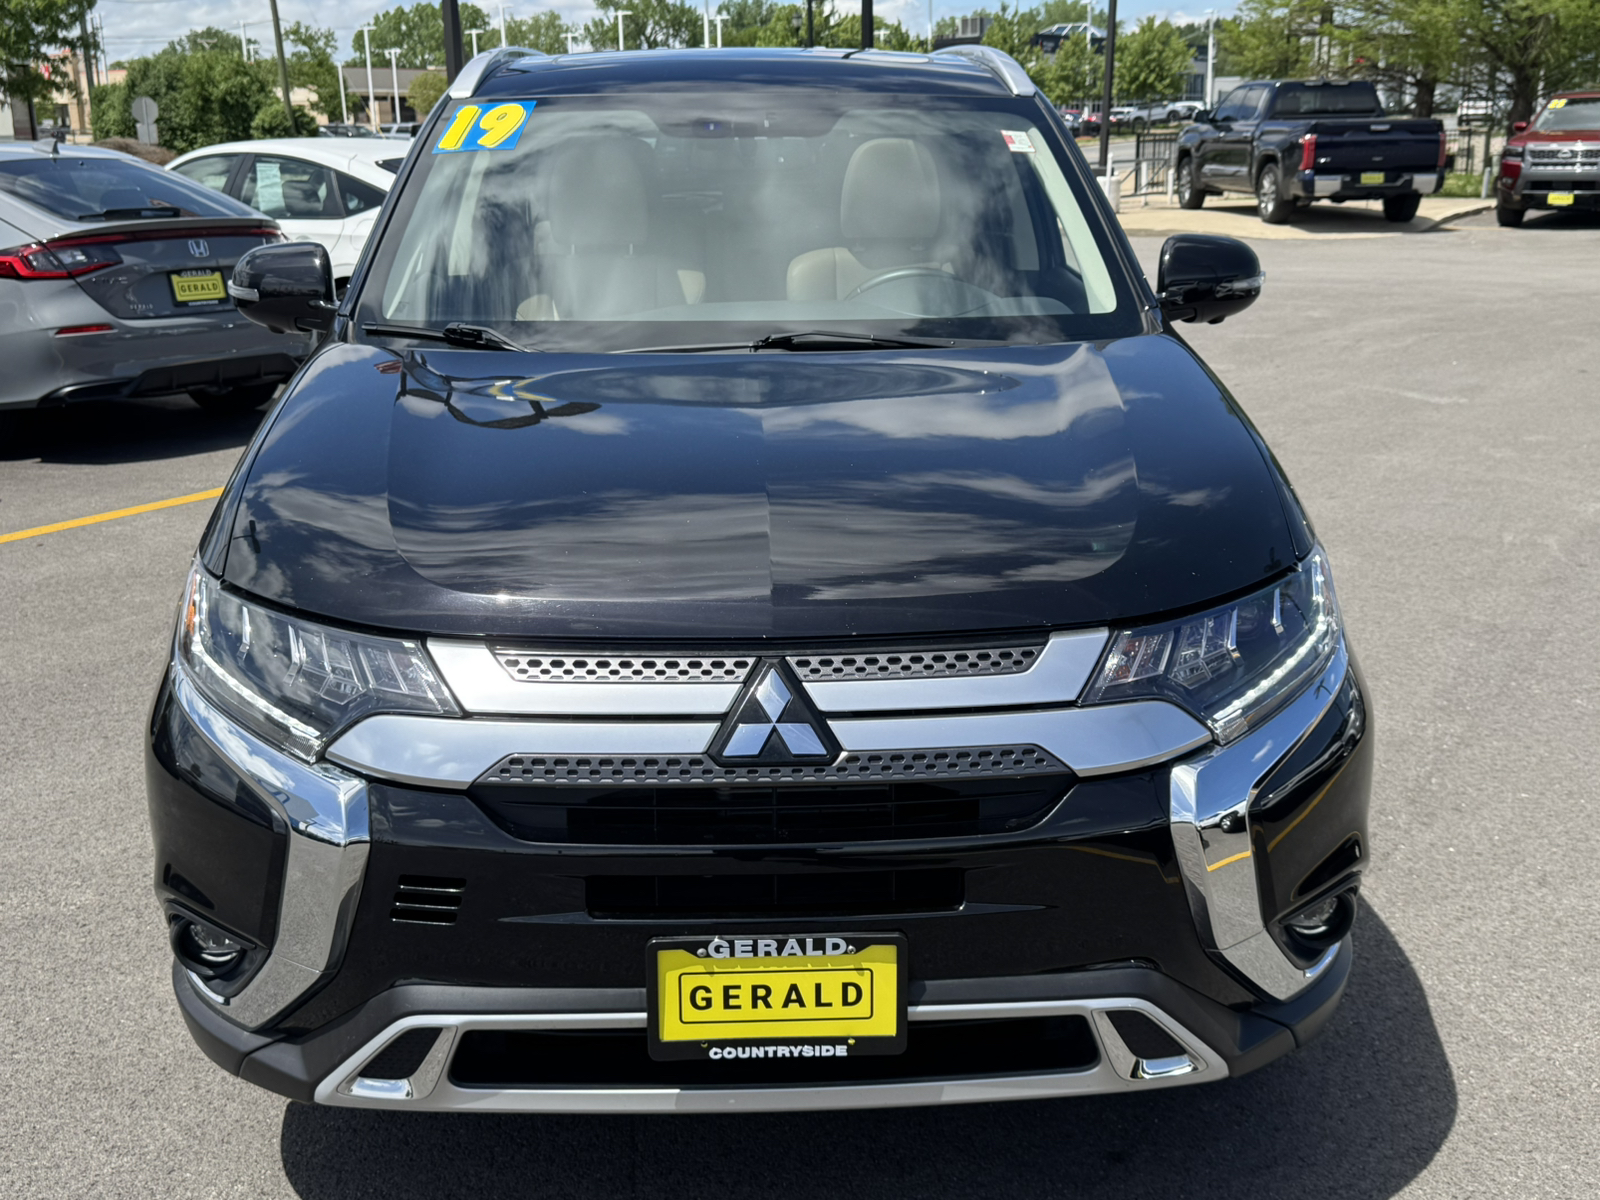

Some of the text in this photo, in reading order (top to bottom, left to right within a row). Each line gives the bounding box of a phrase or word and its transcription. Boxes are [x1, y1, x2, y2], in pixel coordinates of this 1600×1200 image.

[438, 103, 527, 150] 19
[180, 283, 218, 293] GERALD
[707, 937, 847, 959] GERALD
[689, 982, 863, 1010] GERALD
[708, 1044, 848, 1060] COUNTRYSIDE
